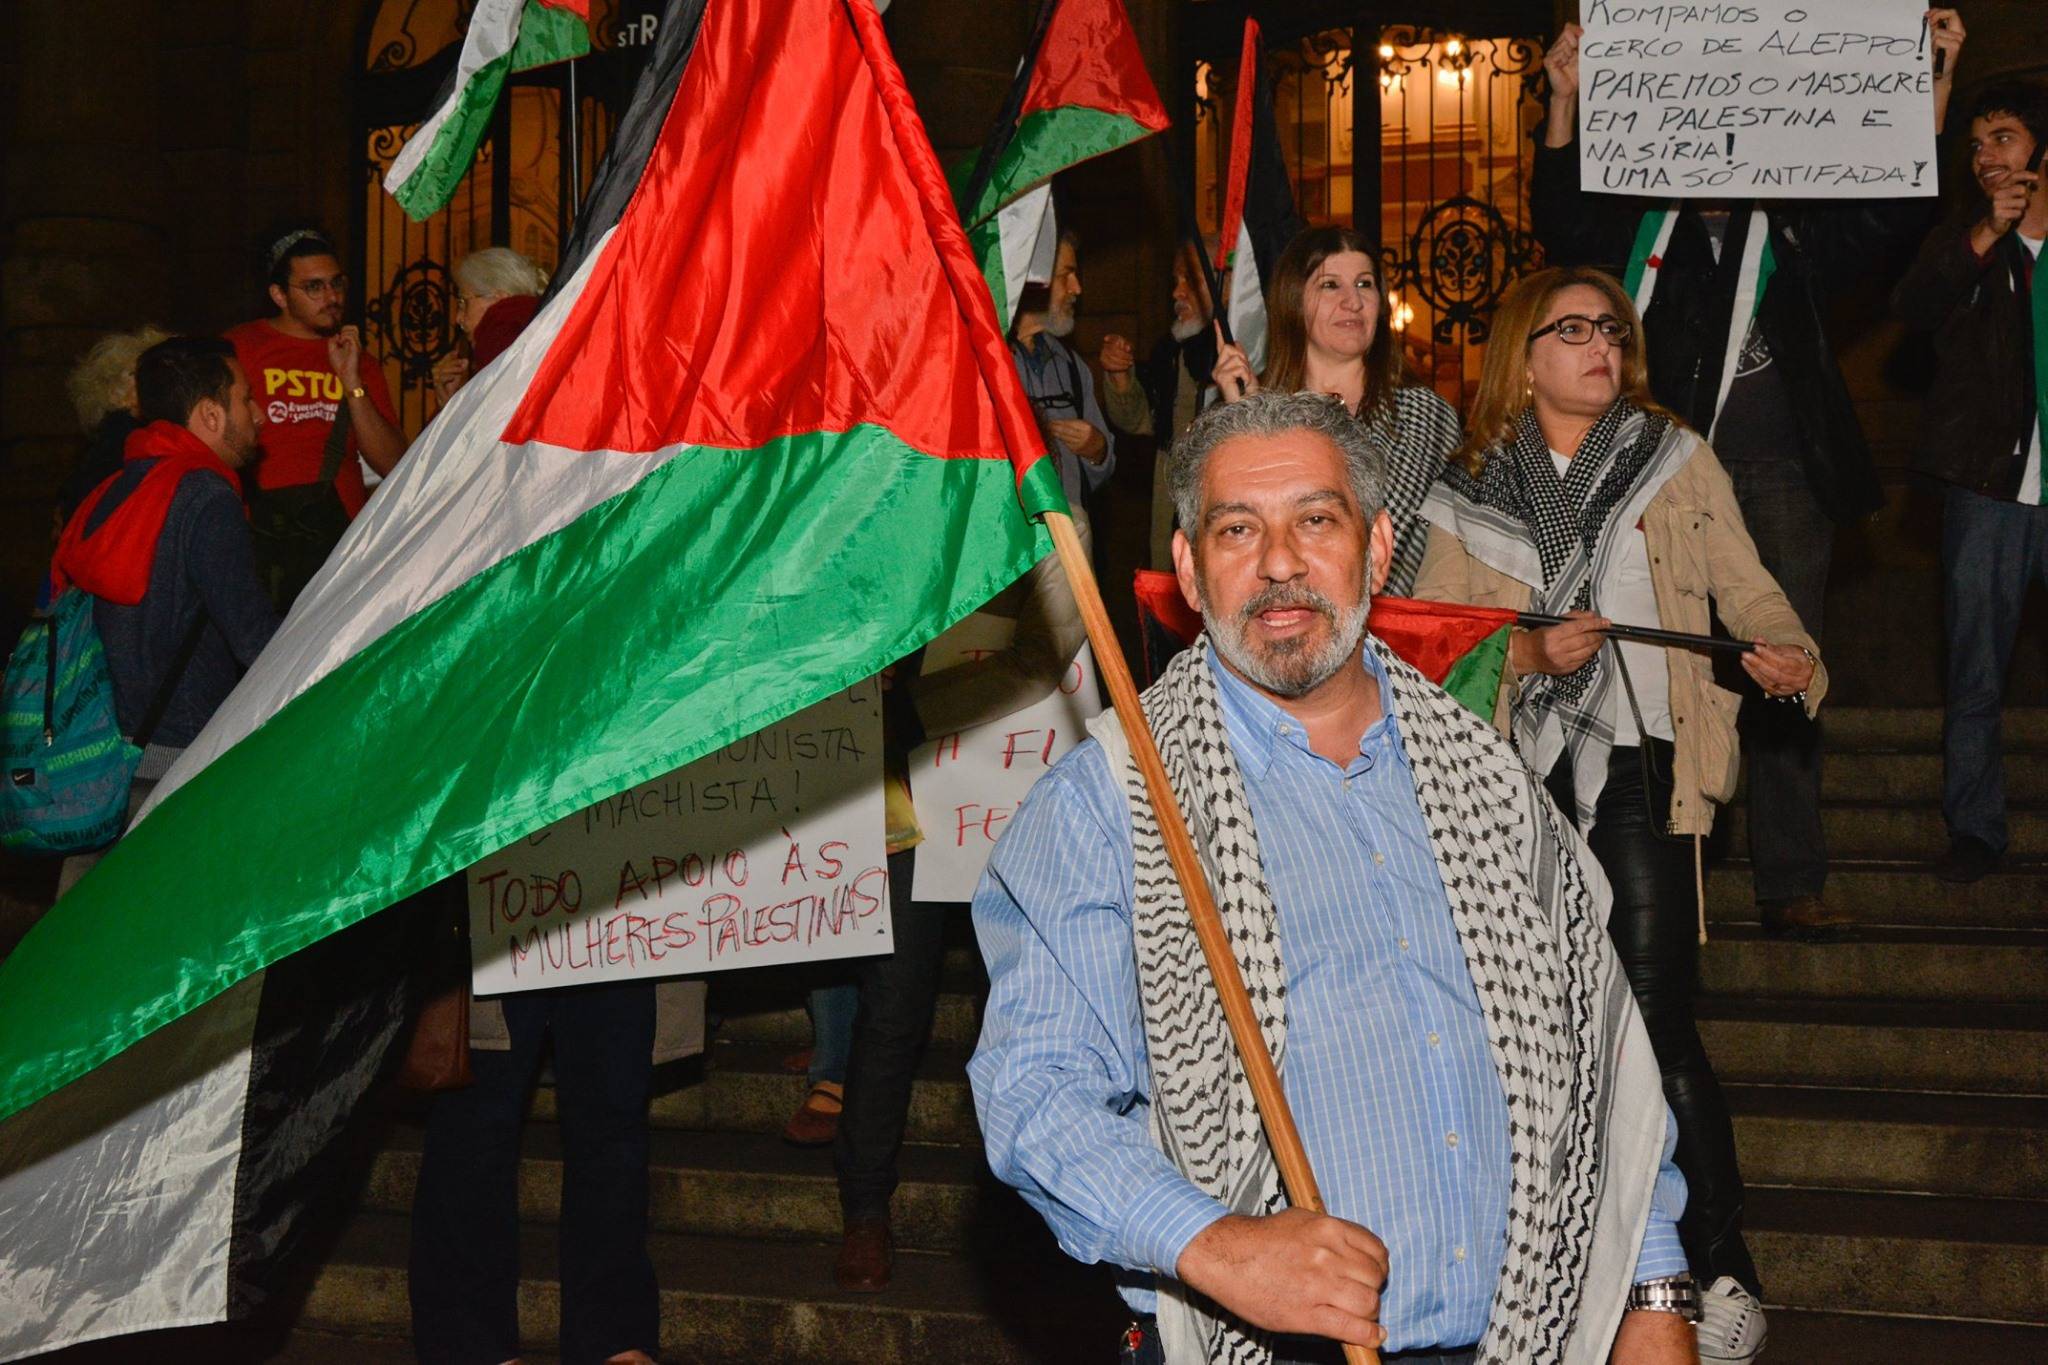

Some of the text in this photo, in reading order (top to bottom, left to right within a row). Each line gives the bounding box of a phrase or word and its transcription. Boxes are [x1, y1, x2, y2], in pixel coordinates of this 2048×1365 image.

[1585, 15, 1928, 61] CERCO DE ALEPPO!
[1588, 69, 1742, 102] PAREMOS
[1788, 71, 1930, 95] MASSACRE
[1586, 107, 1892, 133] EM PALESTINA E
[1603, 161, 1928, 189] UMA SÓ INTIFADA!
[264, 368, 343, 400] PSTU
[479, 870, 582, 935] TODO
[615, 849, 749, 909] APOIO
[510, 912, 696, 977] MULHERES
